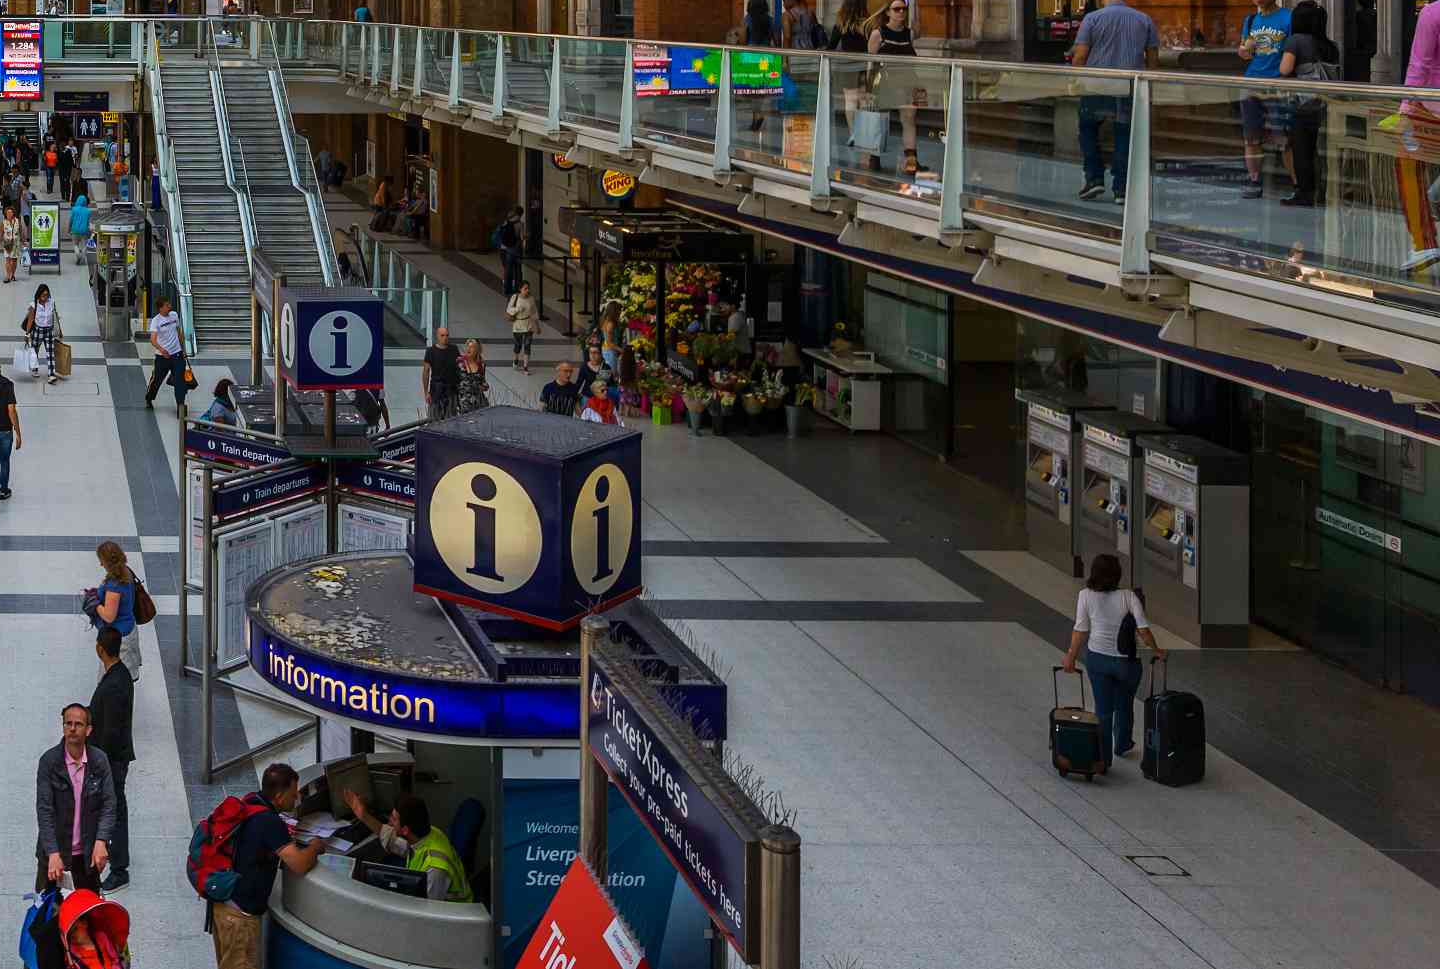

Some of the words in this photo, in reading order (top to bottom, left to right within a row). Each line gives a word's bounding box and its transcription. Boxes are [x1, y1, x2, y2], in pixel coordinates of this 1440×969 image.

[606, 176, 632, 192] KING
[221, 442, 240, 456] Train
[242, 448, 282, 465] departur
[254, 486, 272, 500] Train
[273, 476, 310, 495] departures
[379, 479, 402, 494] Train
[268, 644, 435, 723] information
[604, 687, 688, 819] TicketXpress
[526, 822, 578, 834] Welcome
[604, 733, 628, 778] Collect
[630, 767, 646, 800] your
[647, 792, 682, 852] pre-paid
[684, 840, 718, 896] tickets
[720, 884, 742, 930] here
[526, 846, 576, 866] Liverp
[526, 870, 564, 886] Stre
[608, 872, 646, 887] tion
